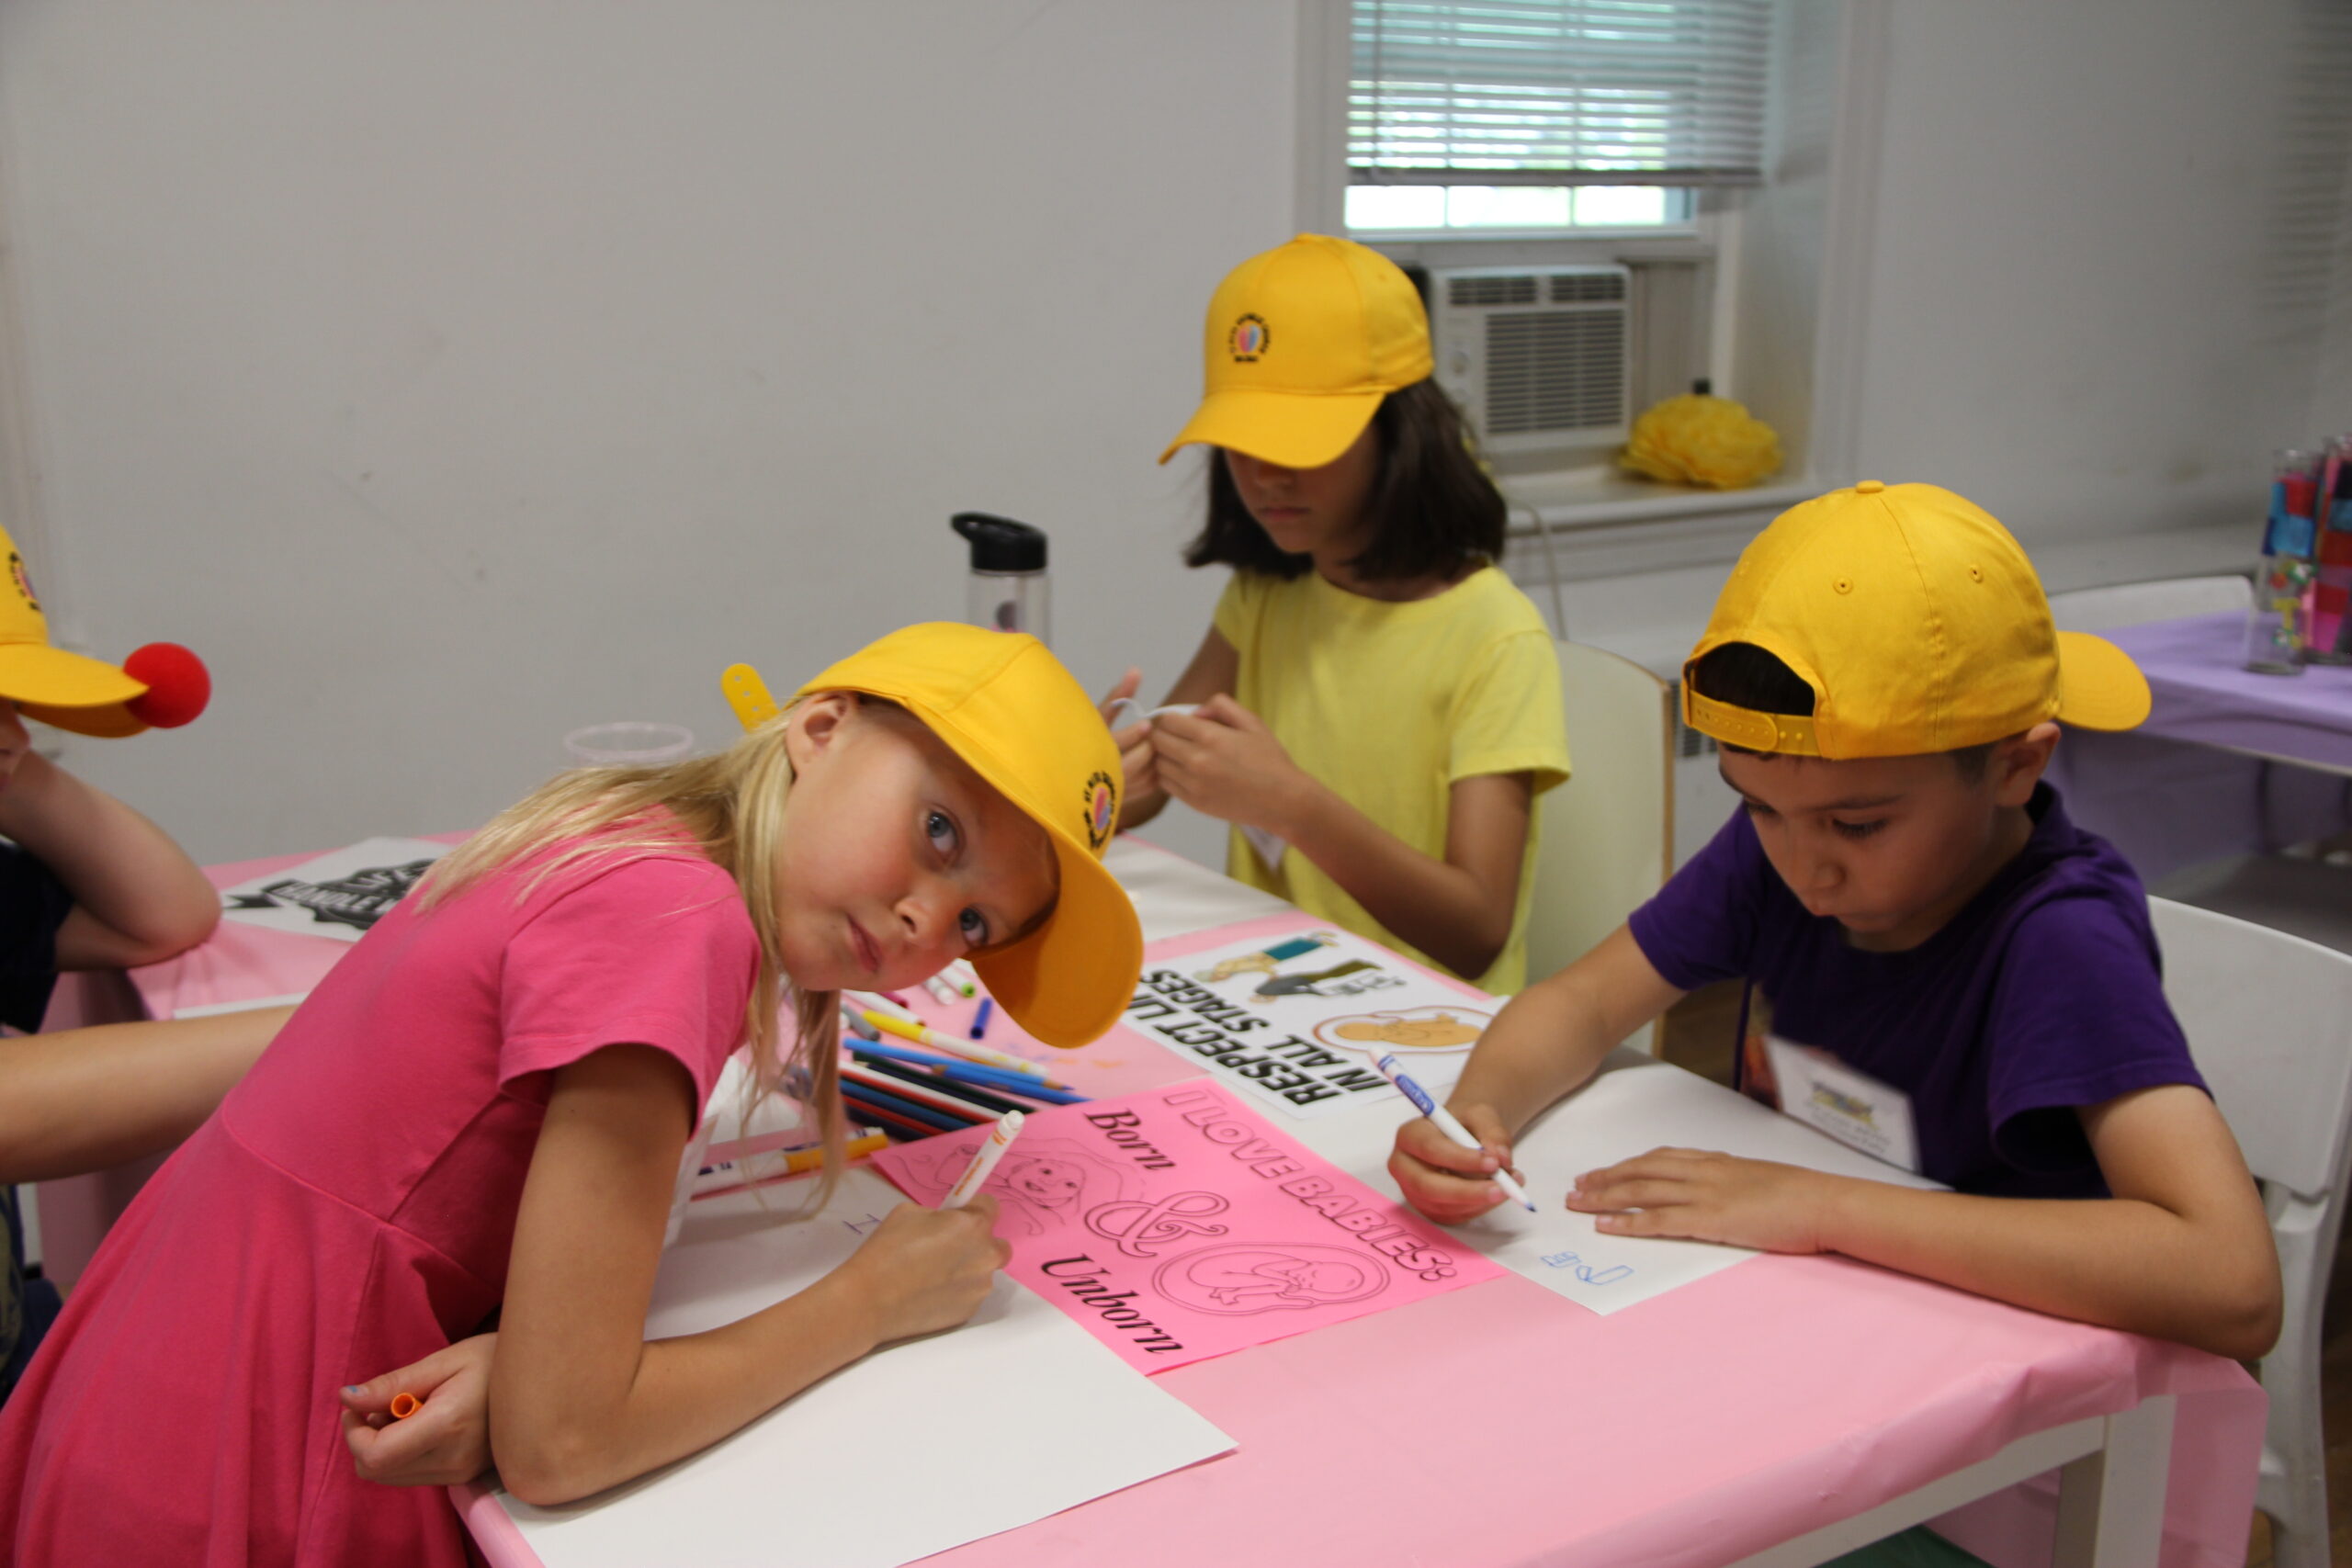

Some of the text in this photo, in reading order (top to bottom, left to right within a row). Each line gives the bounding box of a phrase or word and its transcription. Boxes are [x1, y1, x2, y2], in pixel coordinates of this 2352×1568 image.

[1139, 969, 1390, 1092] IN ALL STAGES
[1152, 1020, 1342, 1105] RESPECT
[1163, 1089, 1209, 1106] I
[1082, 1108, 1177, 1170] Born
[1181, 1105, 1306, 1179] LOVE
[1084, 1190, 1230, 1258] &
[1040, 1253, 1184, 1355] Unborn
